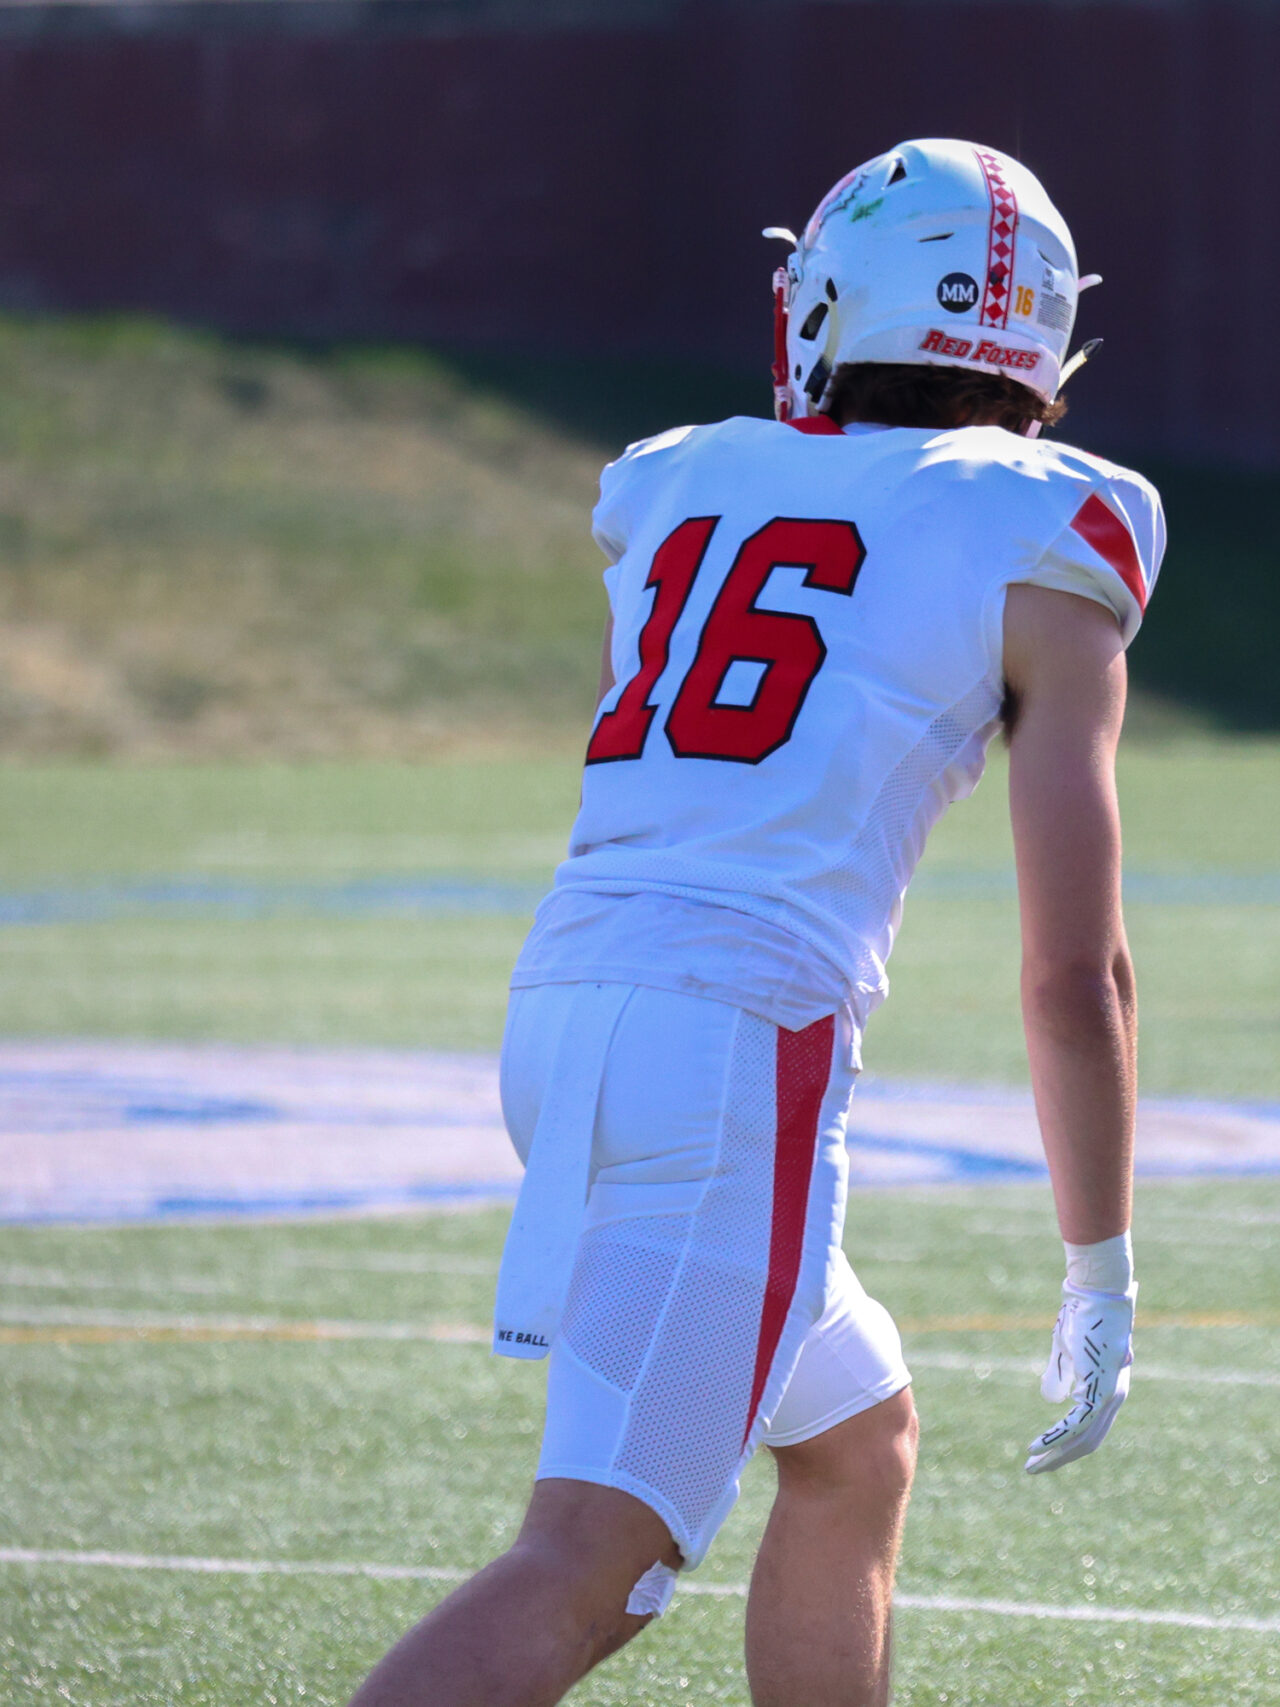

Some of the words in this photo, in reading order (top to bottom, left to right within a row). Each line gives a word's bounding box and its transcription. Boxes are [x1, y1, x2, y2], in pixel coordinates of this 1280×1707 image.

[942, 283, 975, 303] MM
[1015, 285, 1035, 316] 16
[585, 515, 867, 766] 16
